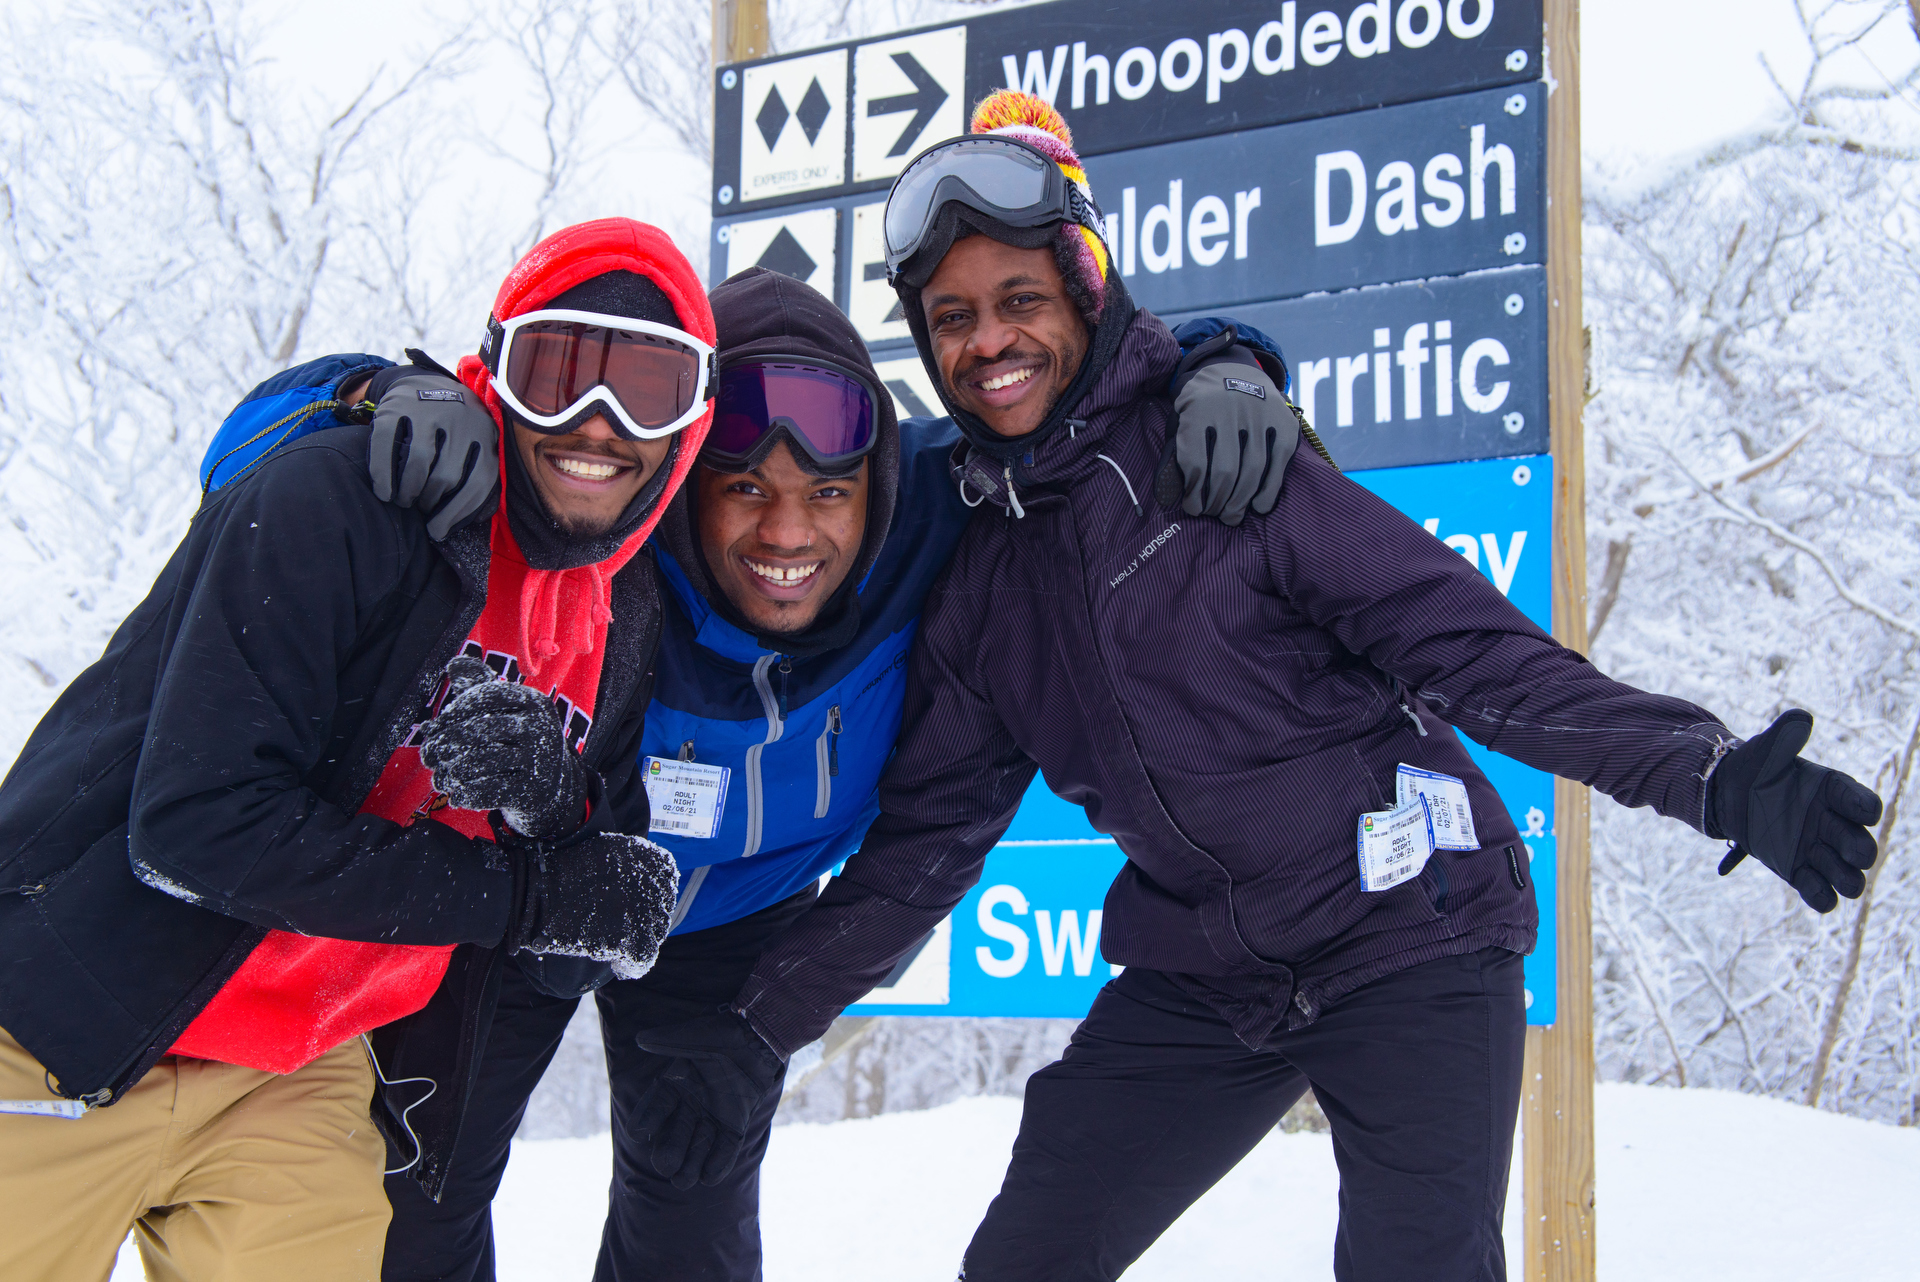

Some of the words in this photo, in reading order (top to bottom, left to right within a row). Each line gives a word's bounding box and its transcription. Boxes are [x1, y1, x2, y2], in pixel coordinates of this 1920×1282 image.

[1002, 0, 1494, 110] Whoopdedoo
[753, 169, 798, 187] EXPERTS
[802, 165, 829, 180] ONLY
[1106, 179, 1261, 276] lder
[1314, 123, 1516, 247] Dash
[1291, 320, 1510, 430] rrific
[1424, 518, 1528, 597] ay
[678, 765, 702, 773] Mountain
[673, 798, 696, 806] NIGHT
[674, 791, 697, 799] ADULT
[1432, 794, 1440, 807] DAY
[1389, 807, 1409, 818] Mountain
[1440, 796, 1451, 829] 02/07/21
[1391, 832, 1411, 846] ADULT
[1392, 840, 1412, 853] NIGHT
[975, 884, 1126, 978] Sw
